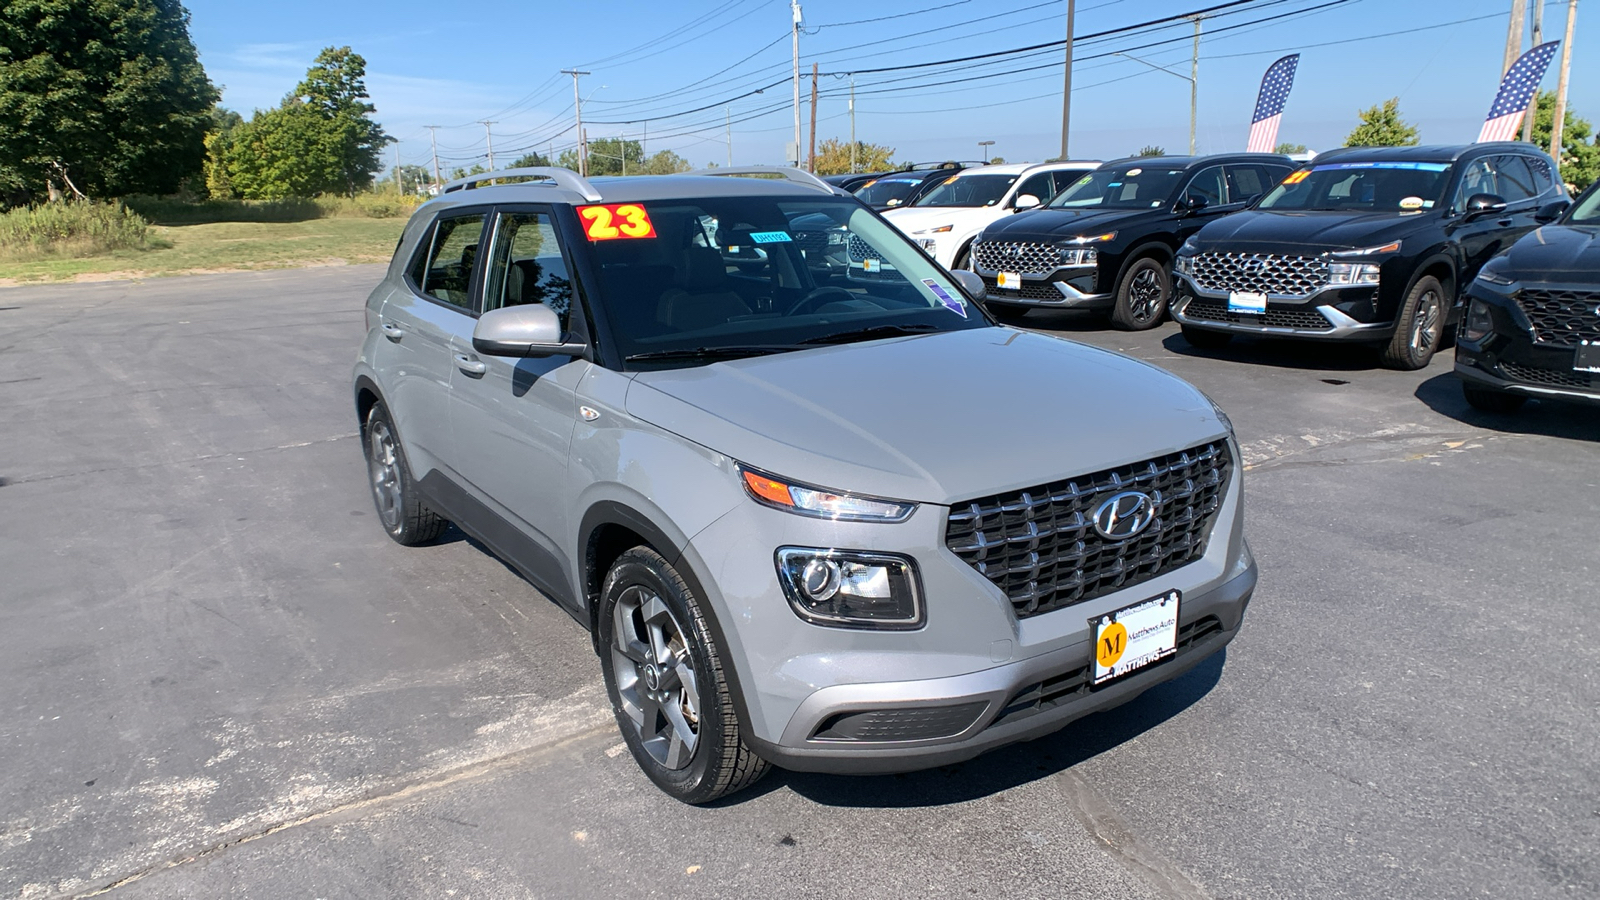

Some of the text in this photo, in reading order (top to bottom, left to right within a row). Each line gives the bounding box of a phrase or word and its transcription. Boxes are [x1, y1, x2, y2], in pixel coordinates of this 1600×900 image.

[581, 205, 651, 239] 23
[754, 233, 788, 242] UH1193
[1127, 624, 1159, 642] Matthews
[1160, 618, 1175, 629] Auto
[1101, 632, 1122, 660] M
[1114, 650, 1160, 677] MATTHEWS
